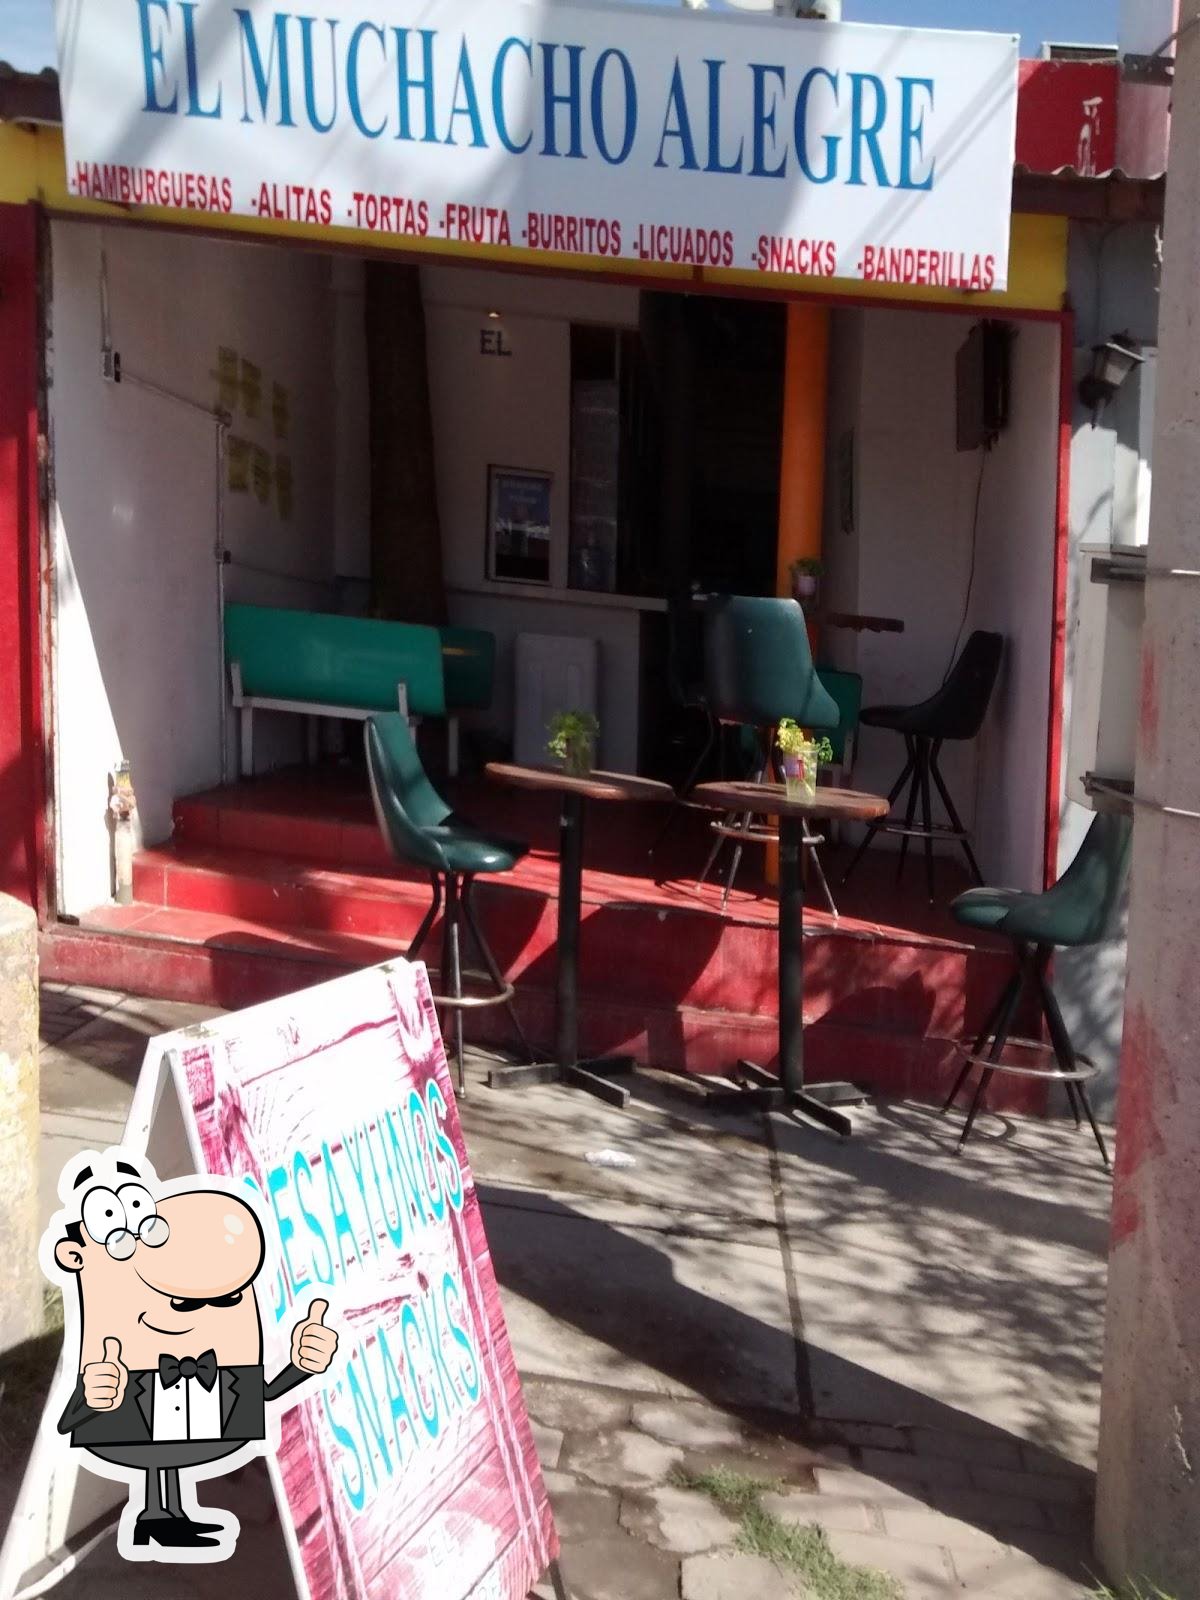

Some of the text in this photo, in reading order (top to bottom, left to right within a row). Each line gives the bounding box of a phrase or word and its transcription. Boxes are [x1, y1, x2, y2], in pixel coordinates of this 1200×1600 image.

[137, 0, 935, 191] EL MUCHACHO ALEGRE
[479, 328, 513, 357] EL
[244, 1080, 464, 1324] ESAYUNOS
[322, 1270, 480, 1511] SNACKS
